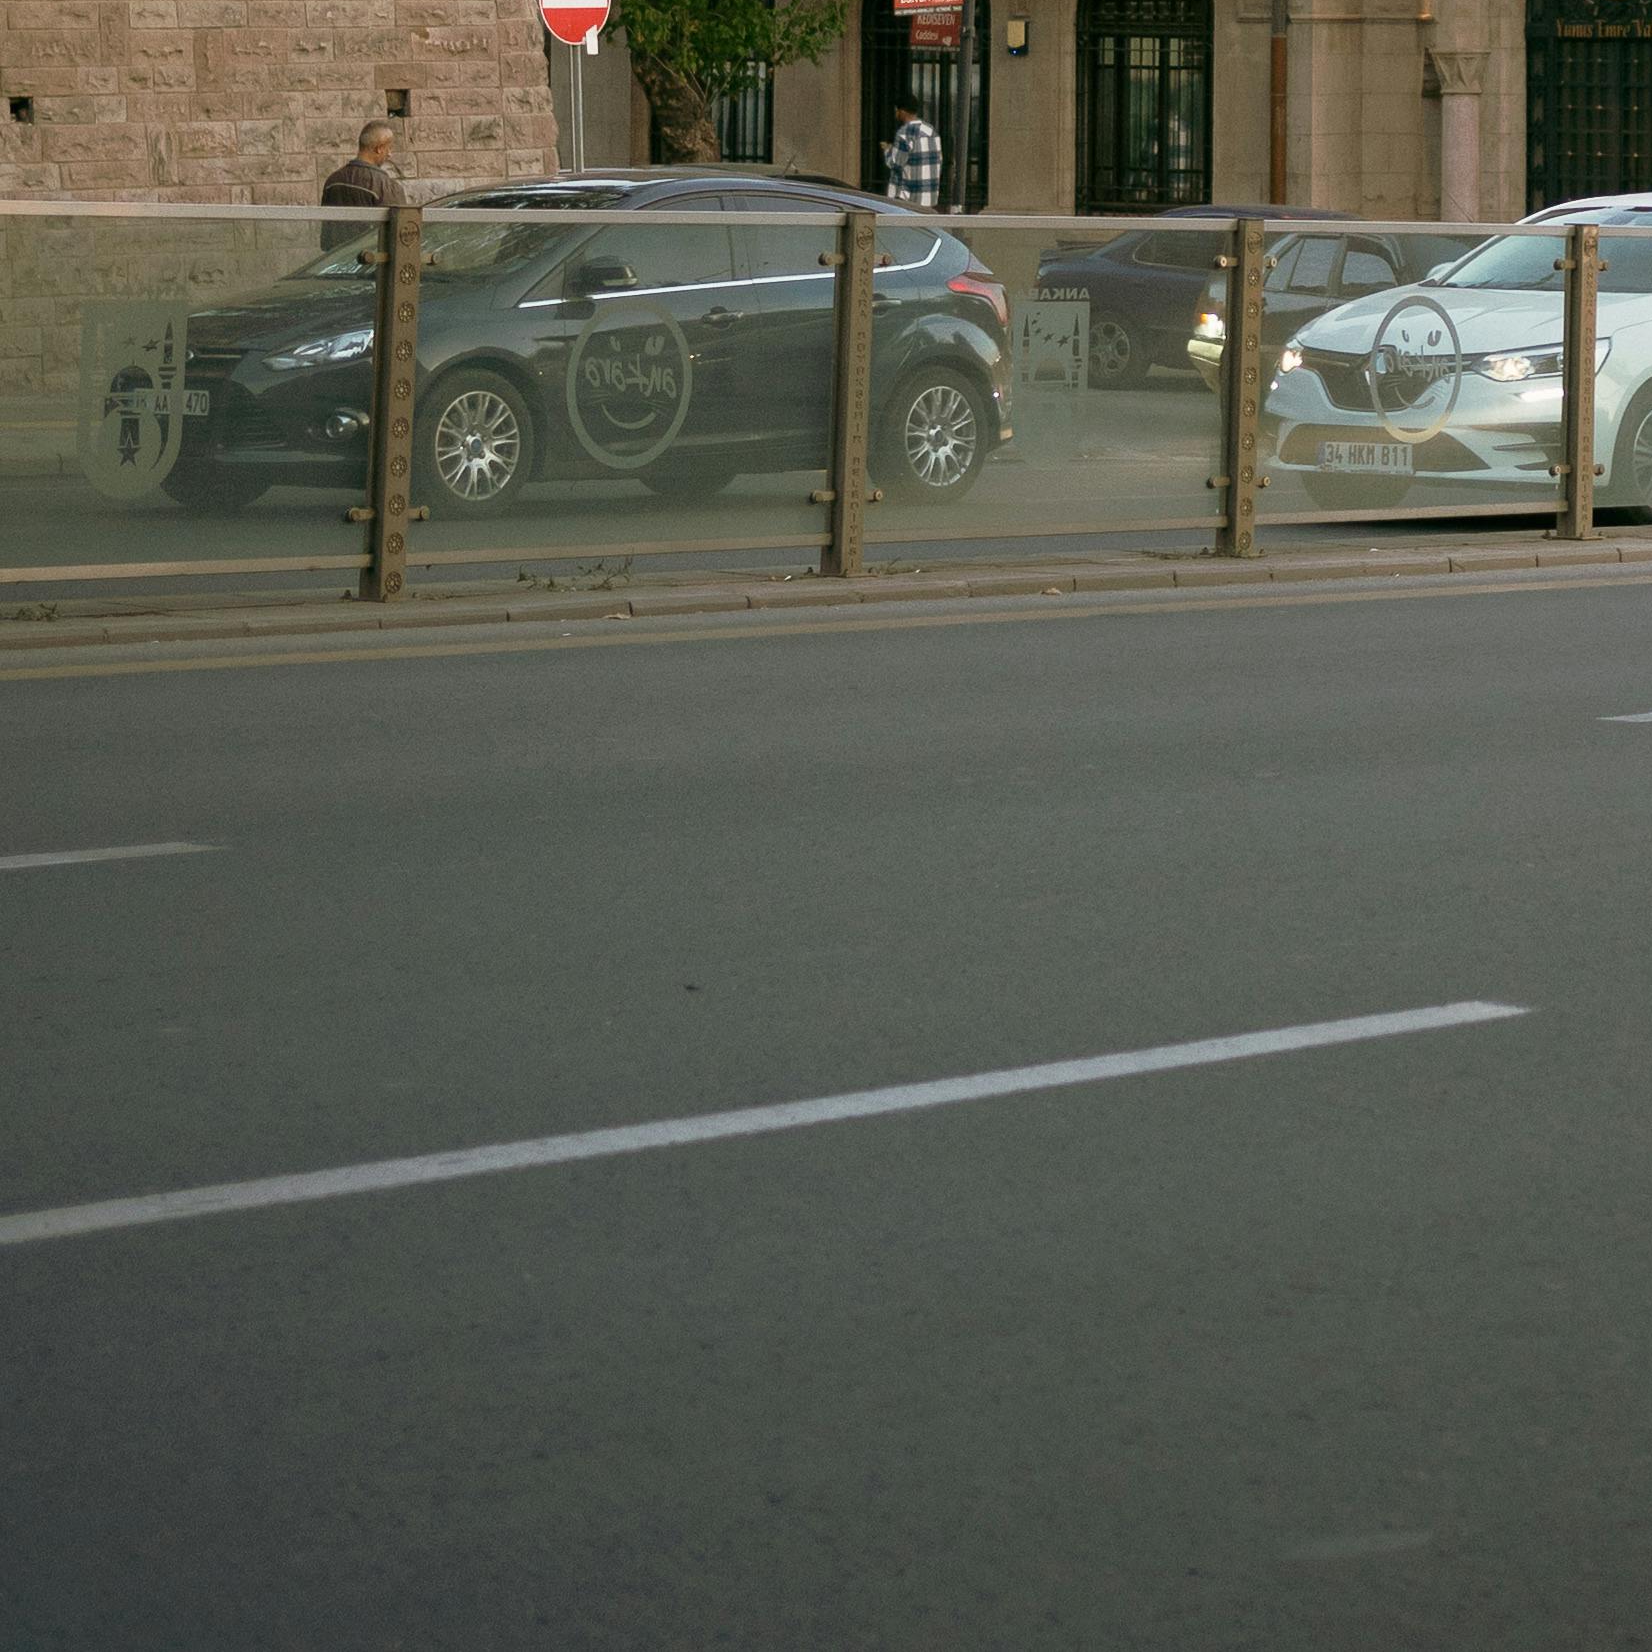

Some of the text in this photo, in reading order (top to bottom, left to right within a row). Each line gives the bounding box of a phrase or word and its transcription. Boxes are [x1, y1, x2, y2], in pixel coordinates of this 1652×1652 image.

[1556, 18, 1592, 37] Yunus
[1596, 19, 1630, 37] Emre
[186, 396, 208, 414] 470
[1326, 444, 1343, 464] 34
[1348, 444, 1376, 466] HKM
